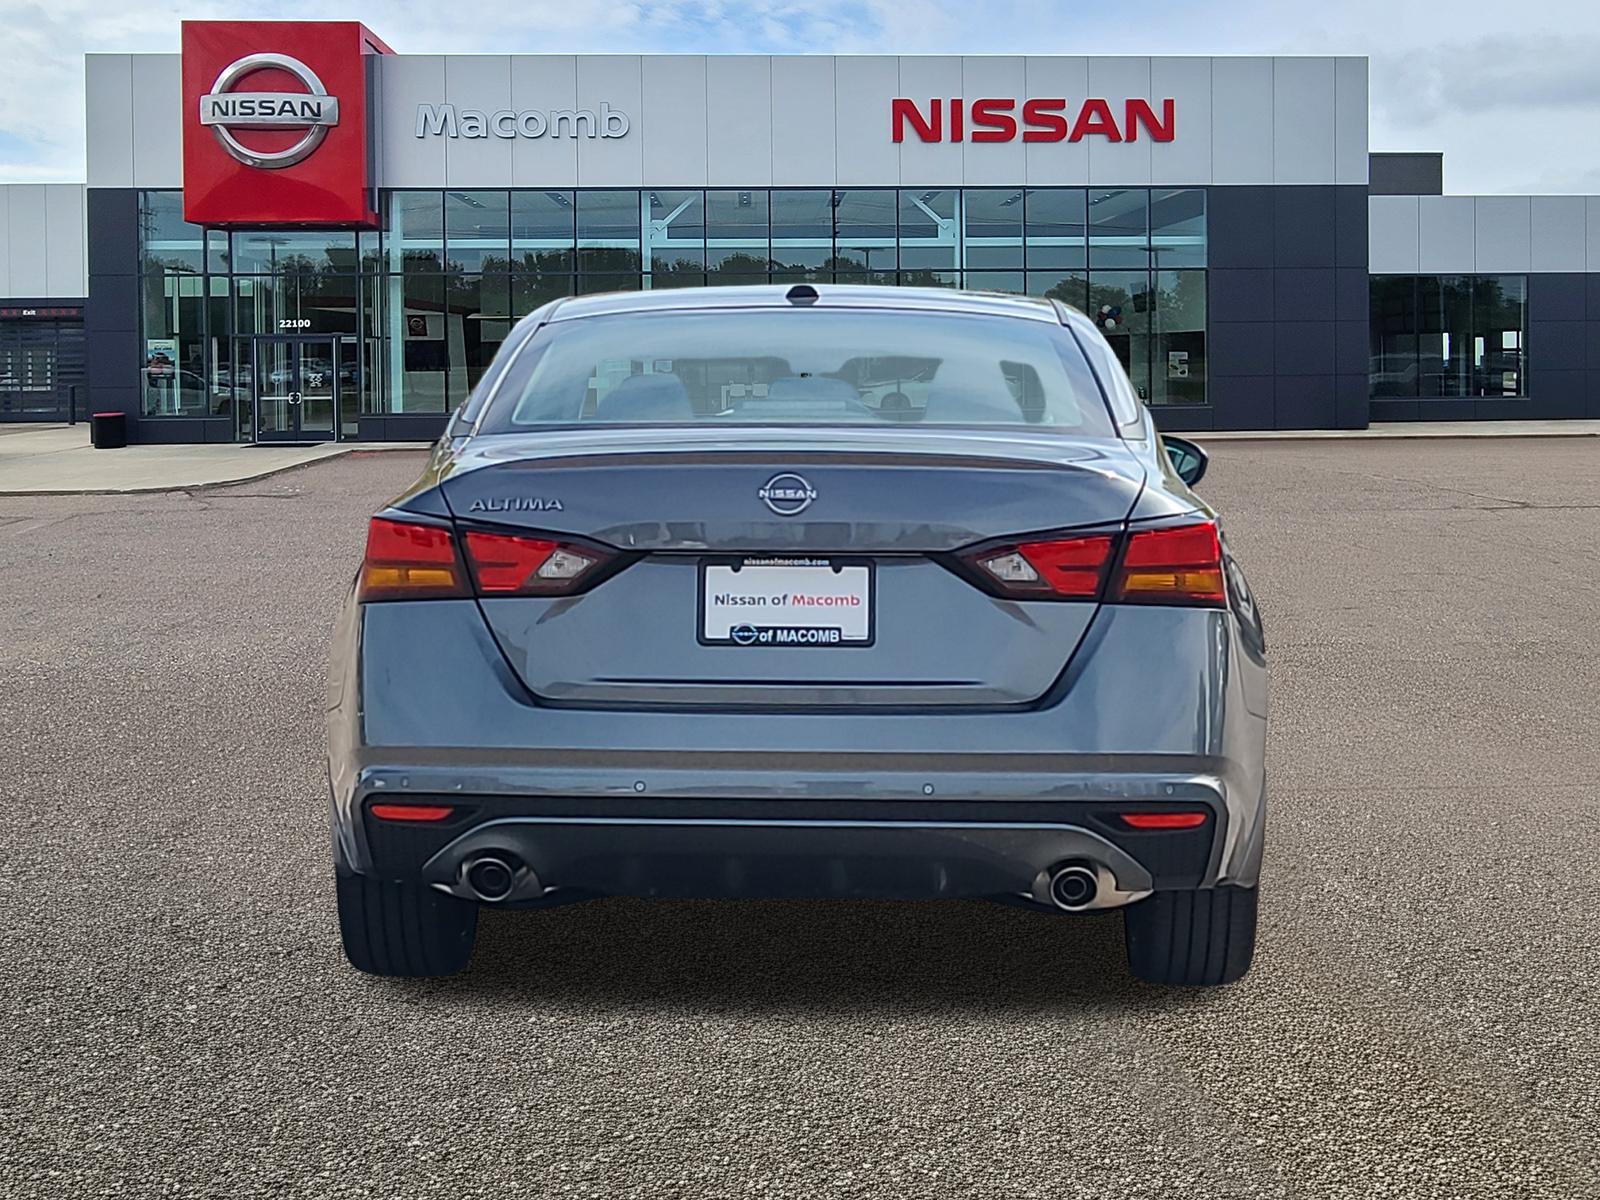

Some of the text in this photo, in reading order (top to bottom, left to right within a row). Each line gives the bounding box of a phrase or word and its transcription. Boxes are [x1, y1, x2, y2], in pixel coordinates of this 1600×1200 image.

[211, 99, 322, 118] NISSAN
[414, 101, 631, 139] Macomb
[892, 98, 1176, 143] NISSAN
[279, 319, 311, 328] 22100
[759, 489, 817, 499] NISSAN
[469, 497, 564, 512] ALTIMA
[714, 593, 860, 606] Nissan of Macomb
[759, 629, 774, 642] of
[776, 629, 840, 643] MACOMB
